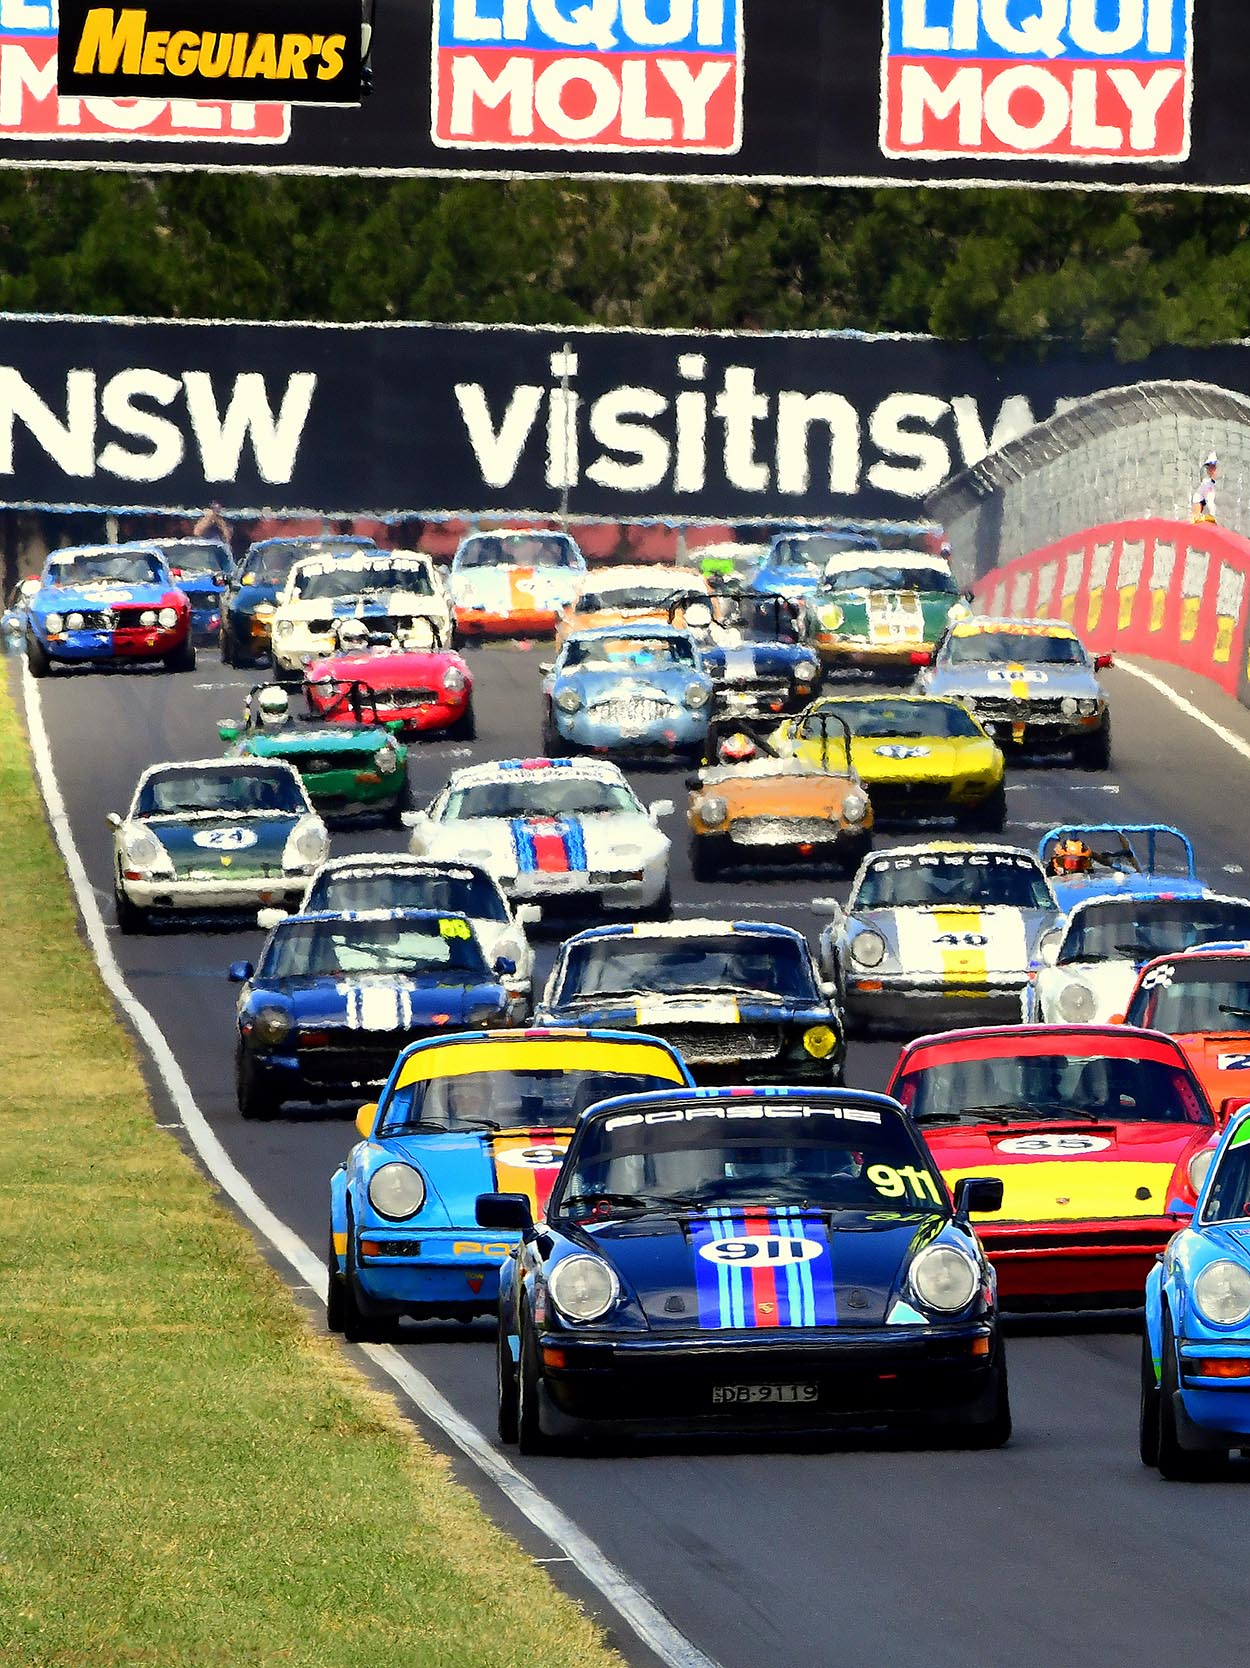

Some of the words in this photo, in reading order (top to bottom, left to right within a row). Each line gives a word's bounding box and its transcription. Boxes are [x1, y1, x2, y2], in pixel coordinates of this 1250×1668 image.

[73, 8, 347, 81] MEGUIAR'S
[901, 0, 1174, 58] LIQUI
[450, 56, 733, 140] MOLY
[900, 65, 1181, 151] MOLY
[0, 365, 318, 485] NSW
[605, 1104, 882, 1132] PORSCHE
[1016, 1139, 1093, 1150] 35
[866, 1164, 943, 1206] 911
[716, 1240, 804, 1259] 911
